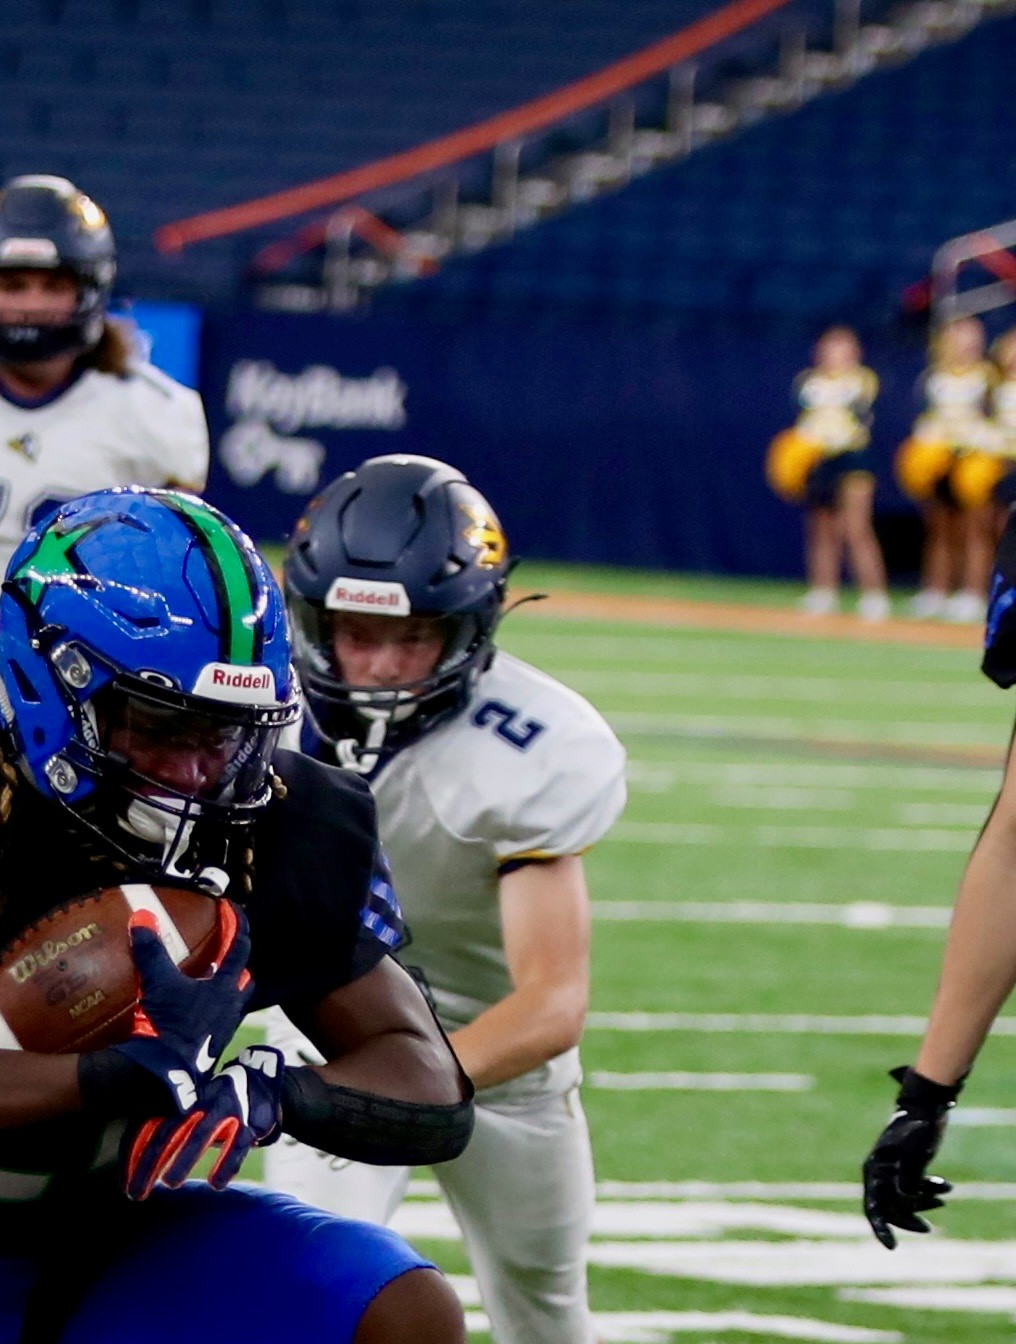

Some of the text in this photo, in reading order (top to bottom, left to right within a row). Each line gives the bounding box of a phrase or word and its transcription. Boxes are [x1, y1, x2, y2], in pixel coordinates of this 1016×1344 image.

[336, 587, 400, 606] Riddell
[212, 669, 270, 689] Riddell
[471, 700, 547, 752] 2
[8, 922, 103, 984] Wilson
[68, 989, 106, 1018] NCAA
